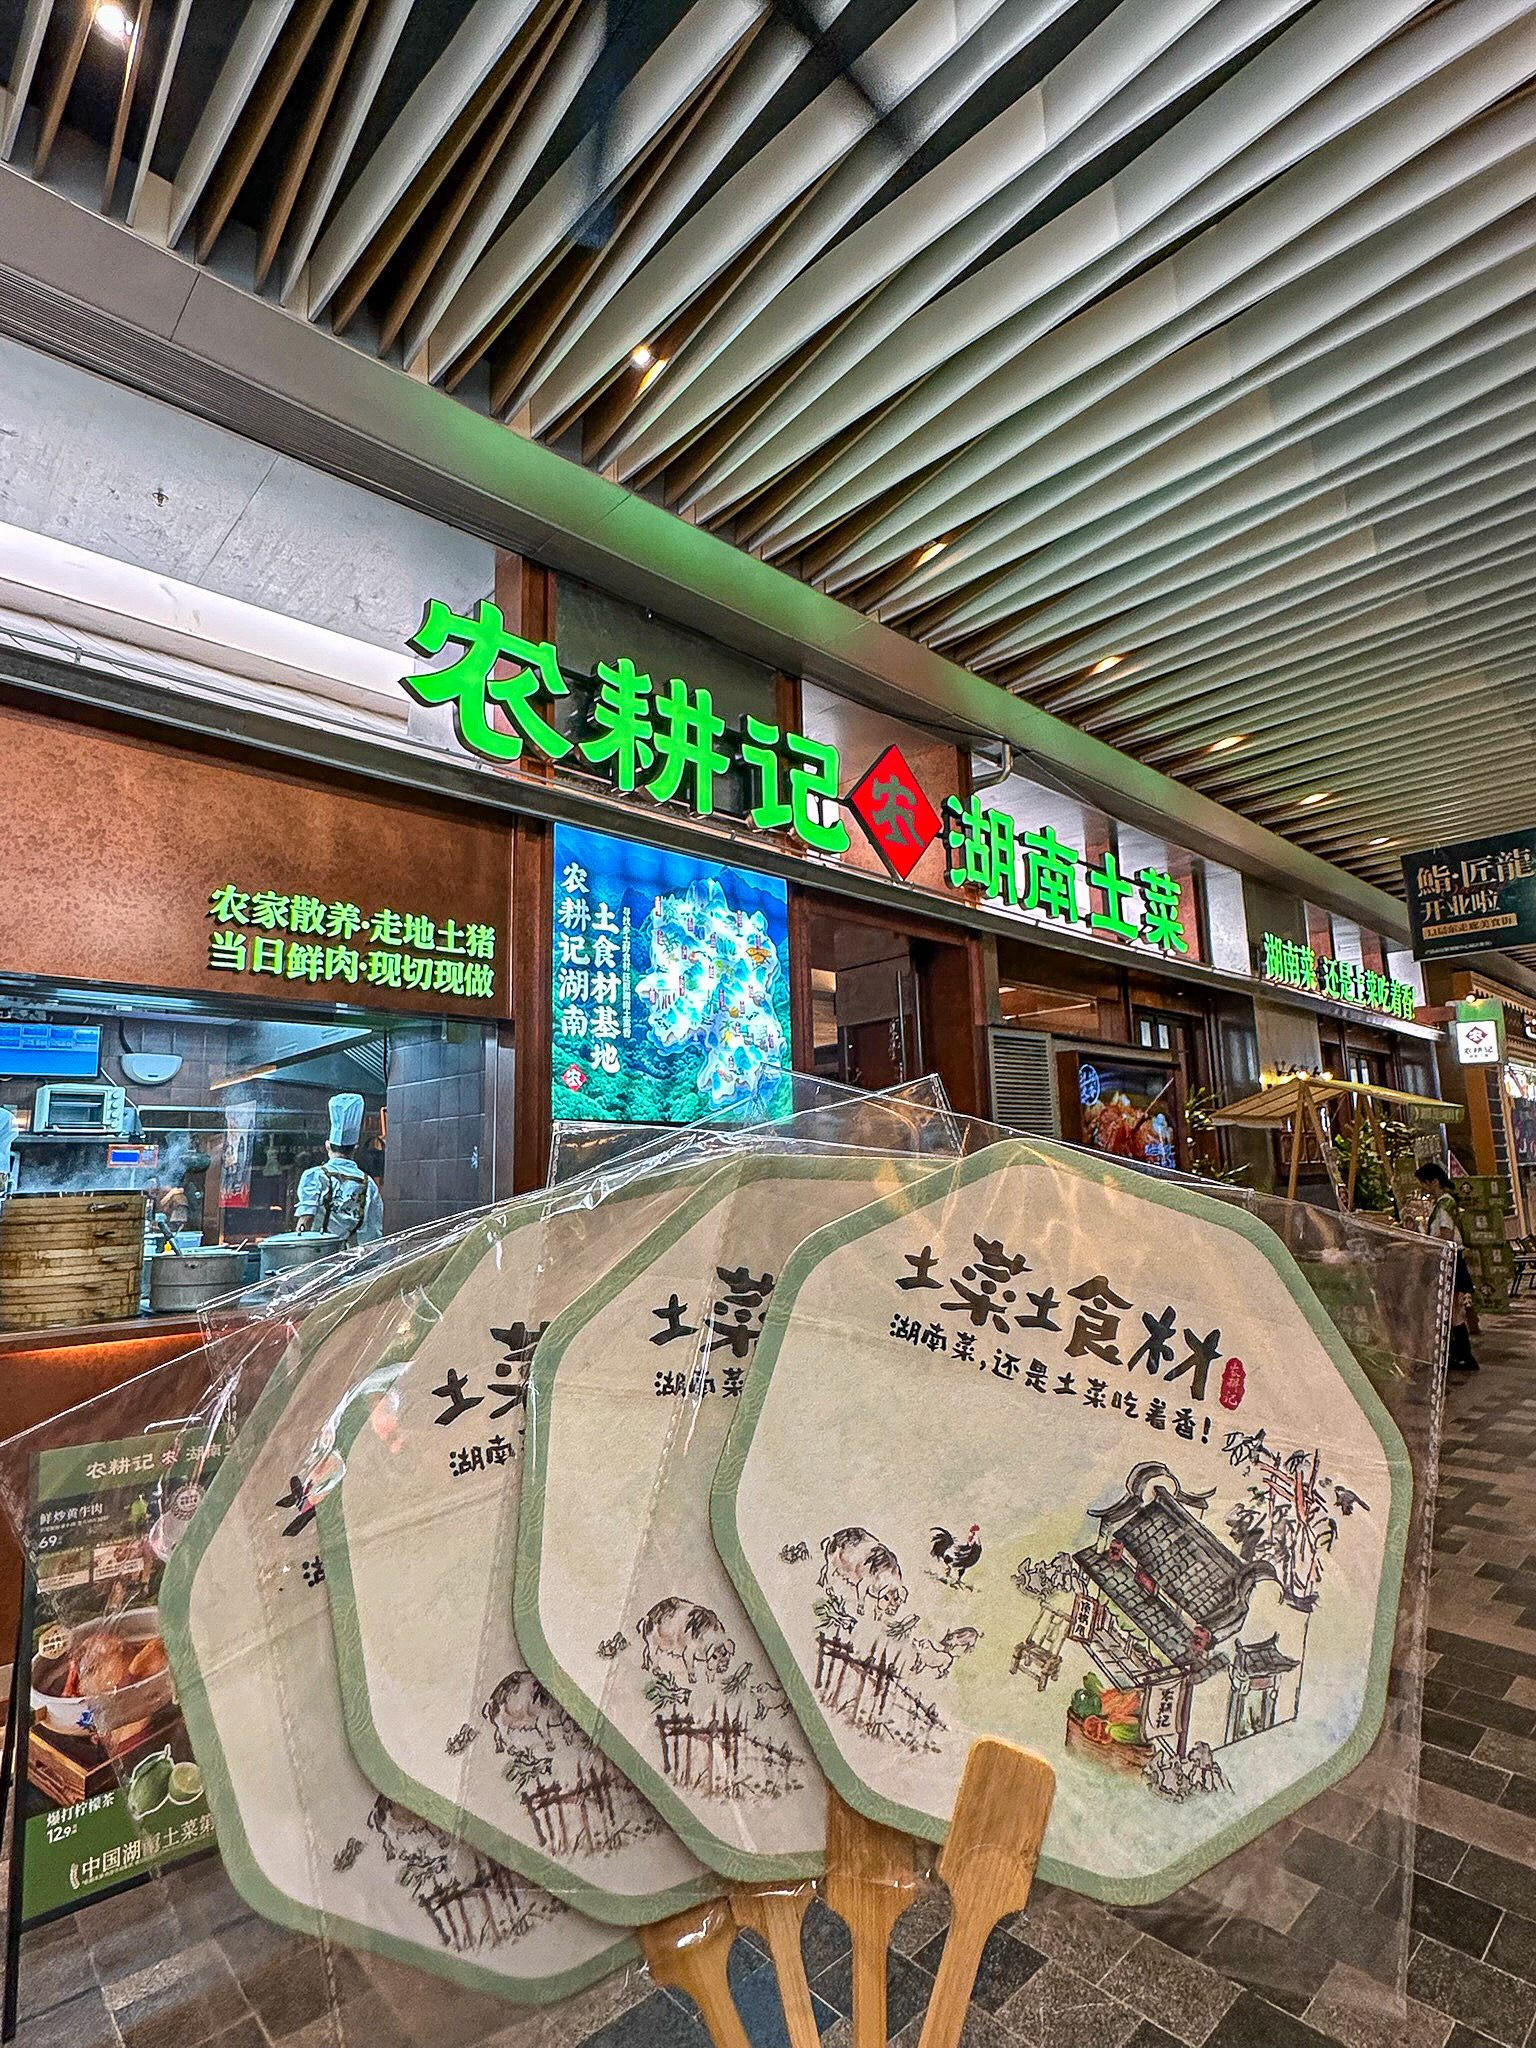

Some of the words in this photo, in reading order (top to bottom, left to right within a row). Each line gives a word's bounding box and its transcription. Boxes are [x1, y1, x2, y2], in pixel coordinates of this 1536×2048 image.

[400, 598, 851, 853] 农耕记
[945, 794, 1189, 954] 湖南土菜
[209, 884, 496, 960] 农家散养·走地土猪
[1420, 888, 1501, 924] 开业啦
[210, 930, 495, 999] 当日鲜肉·现切现做
[557, 861, 592, 1038] 农耕记湖南
[1263, 931, 1318, 991] 湖南菜
[591, 901, 622, 1074] 土食材基地
[649, 1266, 776, 1358] 土菜
[895, 1233, 1222, 1400] 土菜土食材
[654, 1367, 745, 1398] 湖南菜
[86, 1453, 155, 1479] 农耕记
[449, 1428, 526, 1477] 湖南
[38, 1535, 58, 1550] 69
